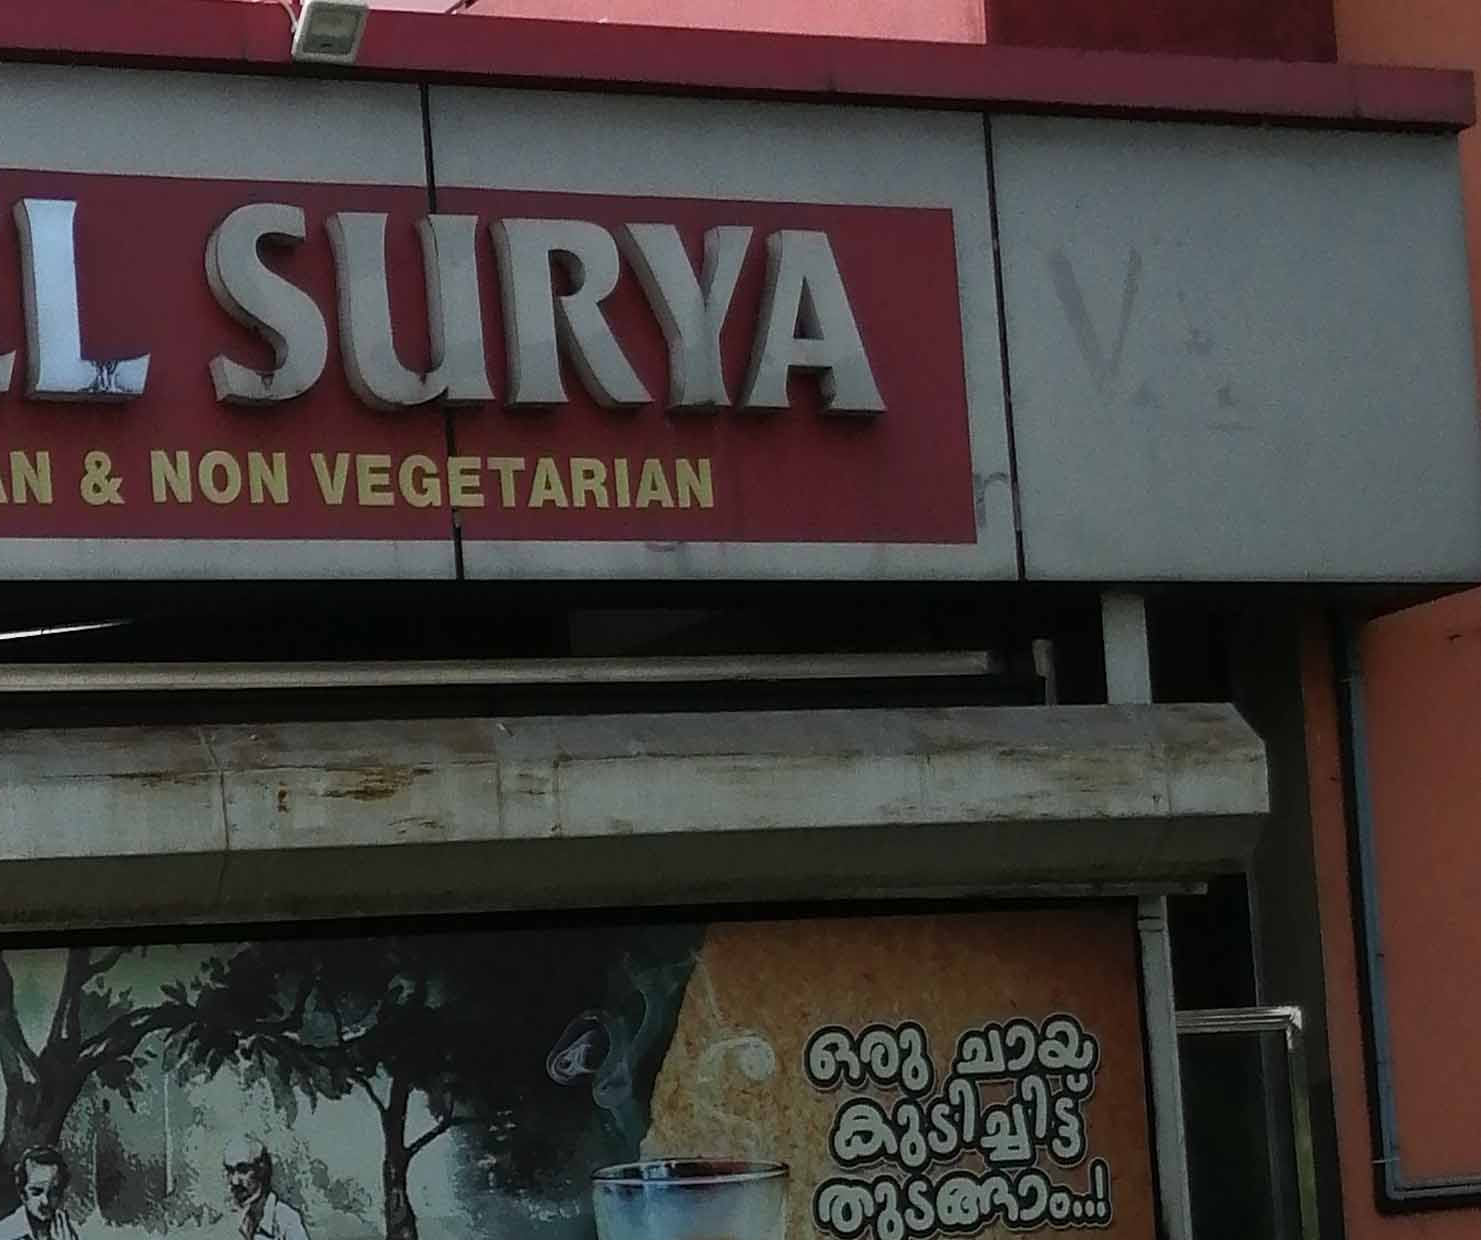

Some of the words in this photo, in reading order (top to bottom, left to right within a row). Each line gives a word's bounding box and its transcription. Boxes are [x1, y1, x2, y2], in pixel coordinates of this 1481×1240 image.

[204, 203, 886, 414] SURYA
[79, 450, 125, 506] &
[149, 450, 290, 504] NON
[310, 453, 714, 508] VEGETARIAN
[807, 1024, 932, 1093] ഒരു
[955, 1019, 1095, 1076] ചായ
